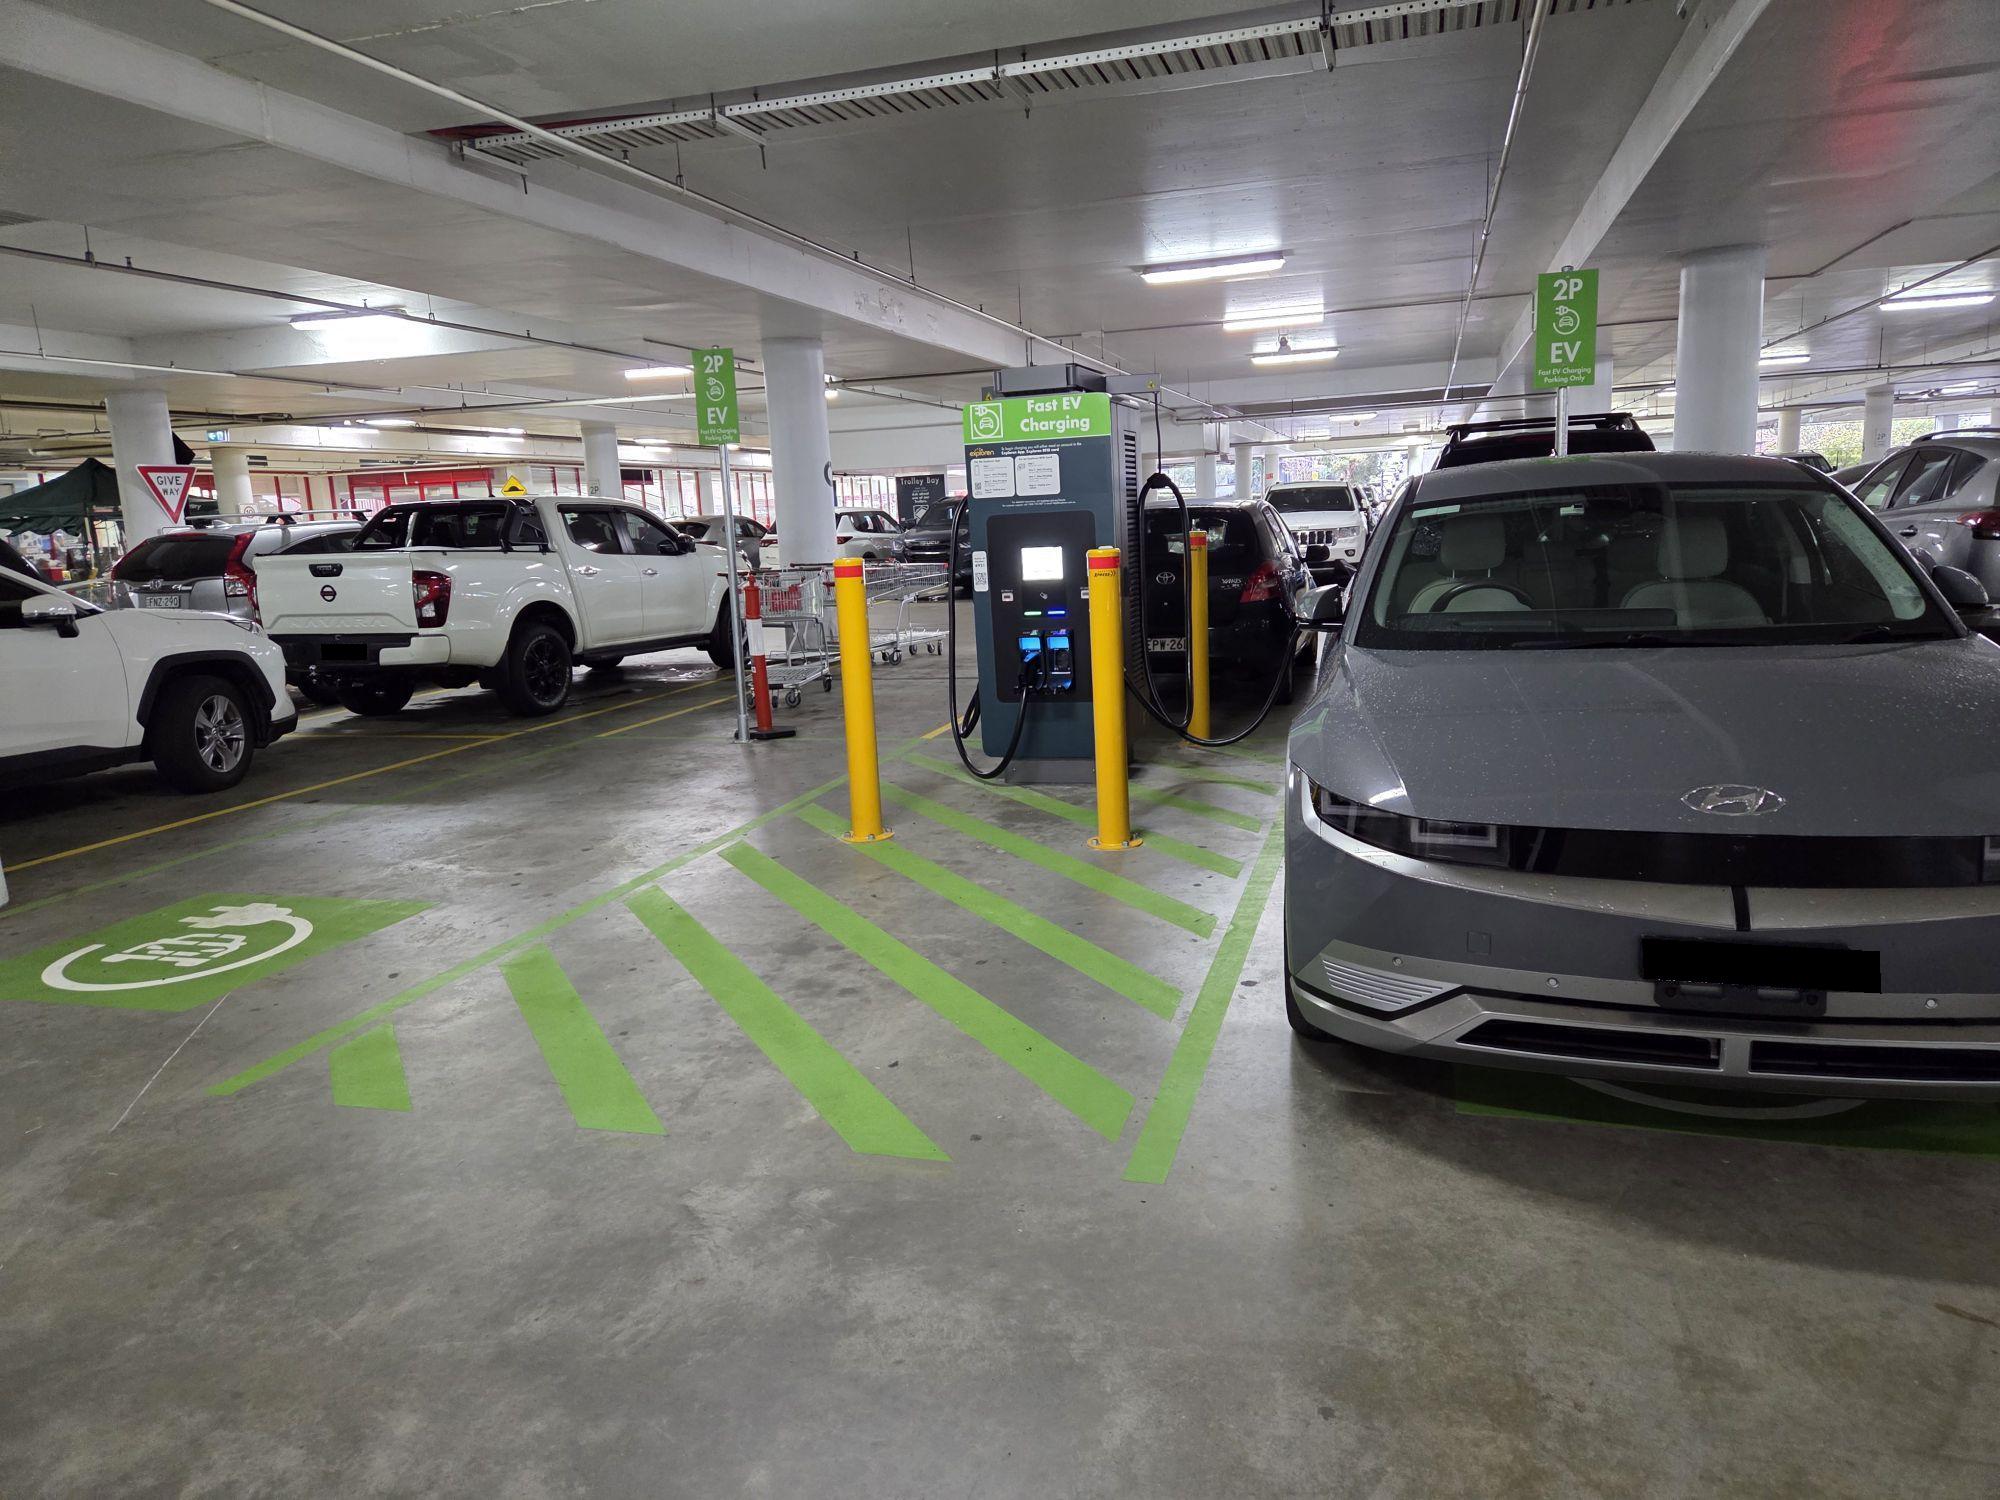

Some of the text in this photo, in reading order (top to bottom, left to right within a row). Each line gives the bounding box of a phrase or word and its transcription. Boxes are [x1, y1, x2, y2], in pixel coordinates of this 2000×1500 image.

[1553, 278, 1583, 301] 2P
[1550, 341, 1582, 363] EV
[703, 355, 724, 374] 2P
[1538, 366, 1591, 376] Fast EV Charging
[1569, 374, 1585, 382] Only
[1027, 396, 1082, 413] Fast EV
[707, 406, 728, 425] EV
[1020, 415, 1090, 433] Charging
[716, 427, 737, 436] Charging
[722, 433, 734, 441] Only
[156, 476, 182, 486] GIVE
[900, 476, 940, 486] Trolley Bay
[162, 488, 180, 496] WAY
[590, 485, 599, 495] 2P
[288, 616, 388, 628] NAVARA
